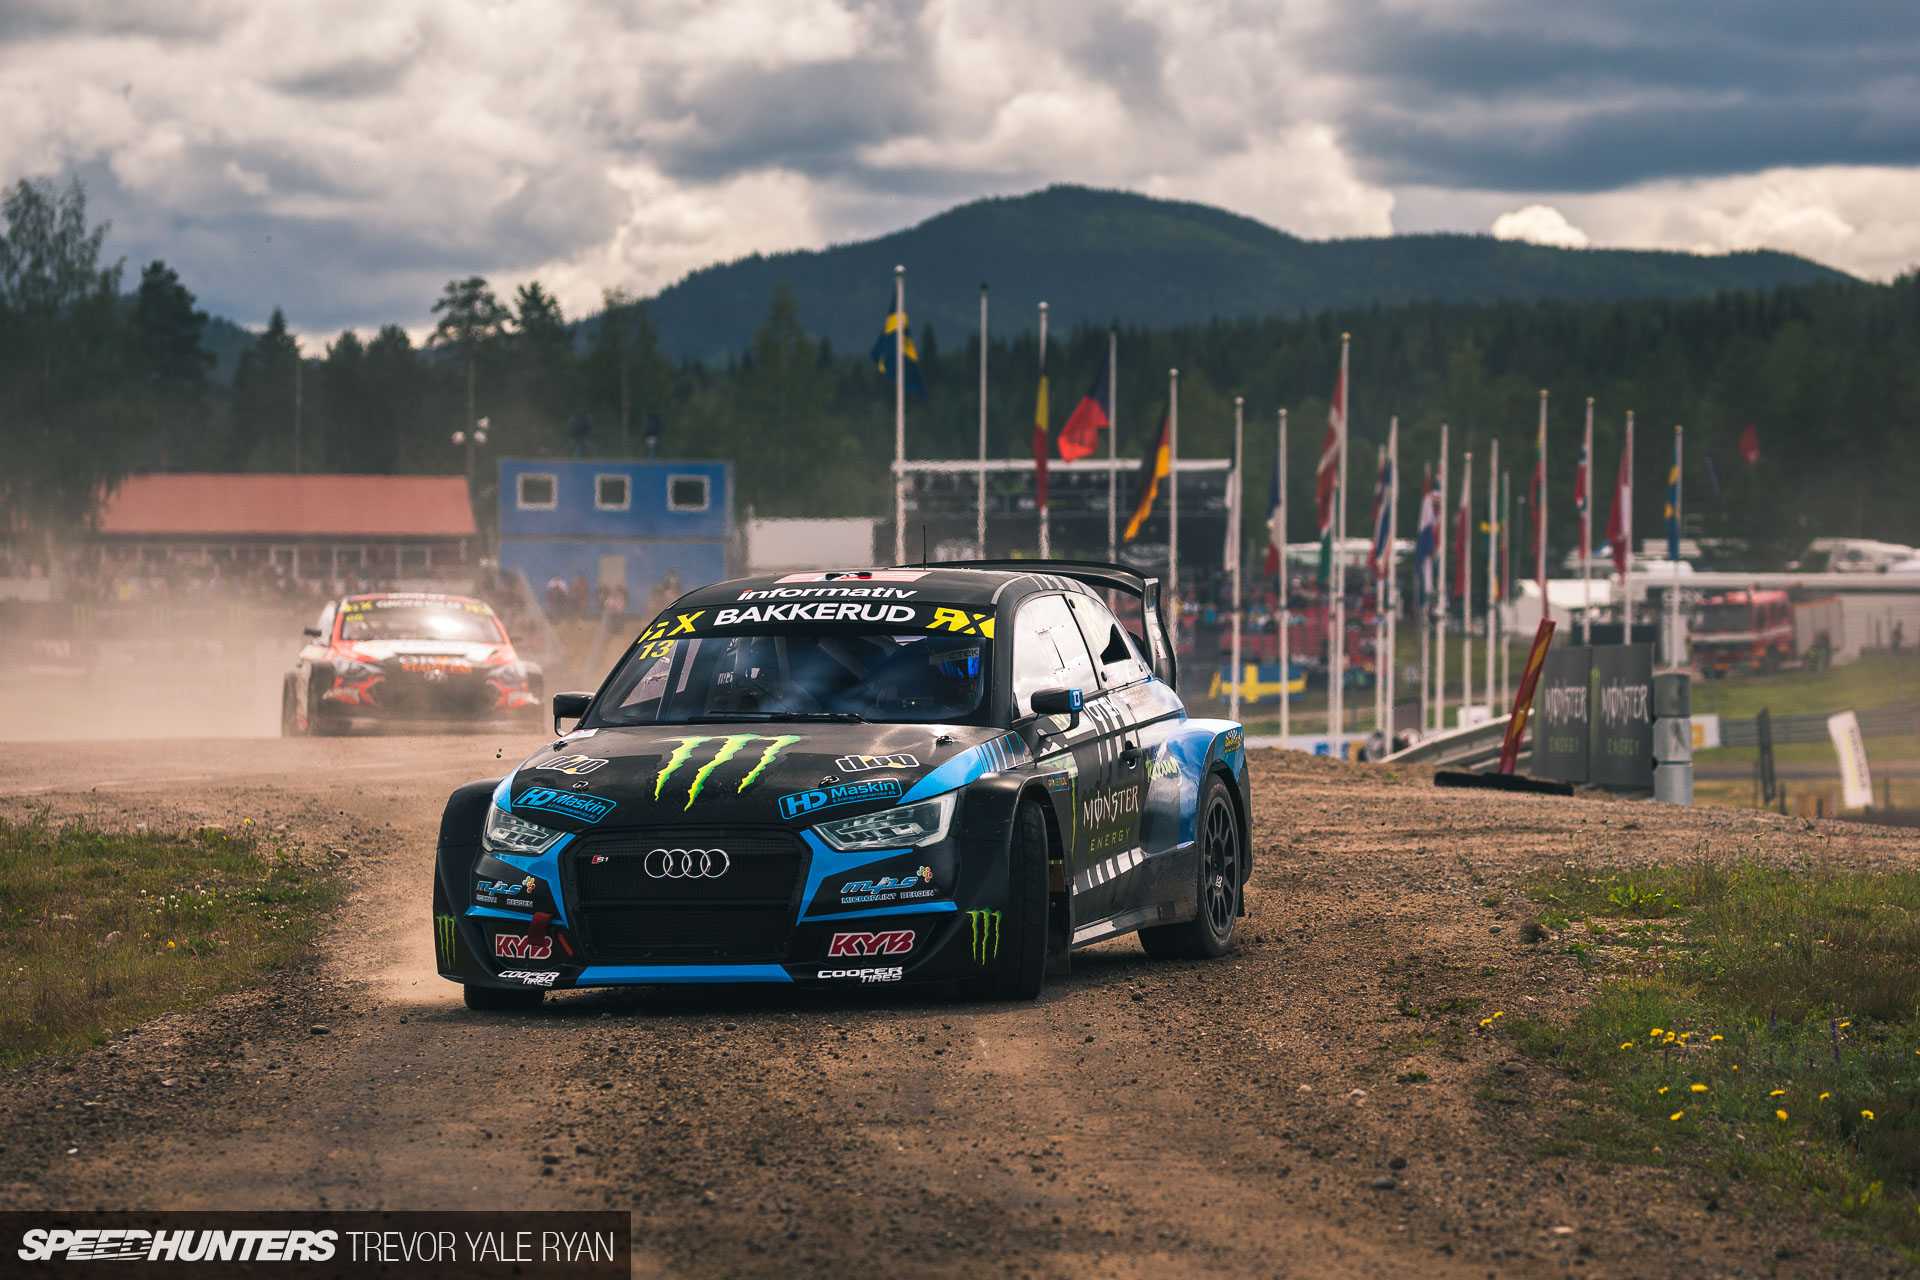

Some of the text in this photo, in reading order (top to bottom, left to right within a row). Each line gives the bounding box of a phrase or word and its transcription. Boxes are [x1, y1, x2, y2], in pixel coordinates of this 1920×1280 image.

[737, 587, 917, 601] informativ
[713, 603, 916, 626] BAKKERUD
[639, 639, 675, 660] 13
[517, 788, 607, 815] HD Maskin
[786, 781, 895, 816] HD Maskin
[1083, 785, 1139, 830] MONSTER
[1090, 827, 1131, 851] ENERGY
[900, 889, 935, 899] BERGEN
[827, 930, 916, 957] KYB
[498, 970, 560, 982] COOPER
[522, 976, 554, 987] TIRES
[817, 966, 903, 979] COOPER
[861, 973, 902, 984] TIRES
